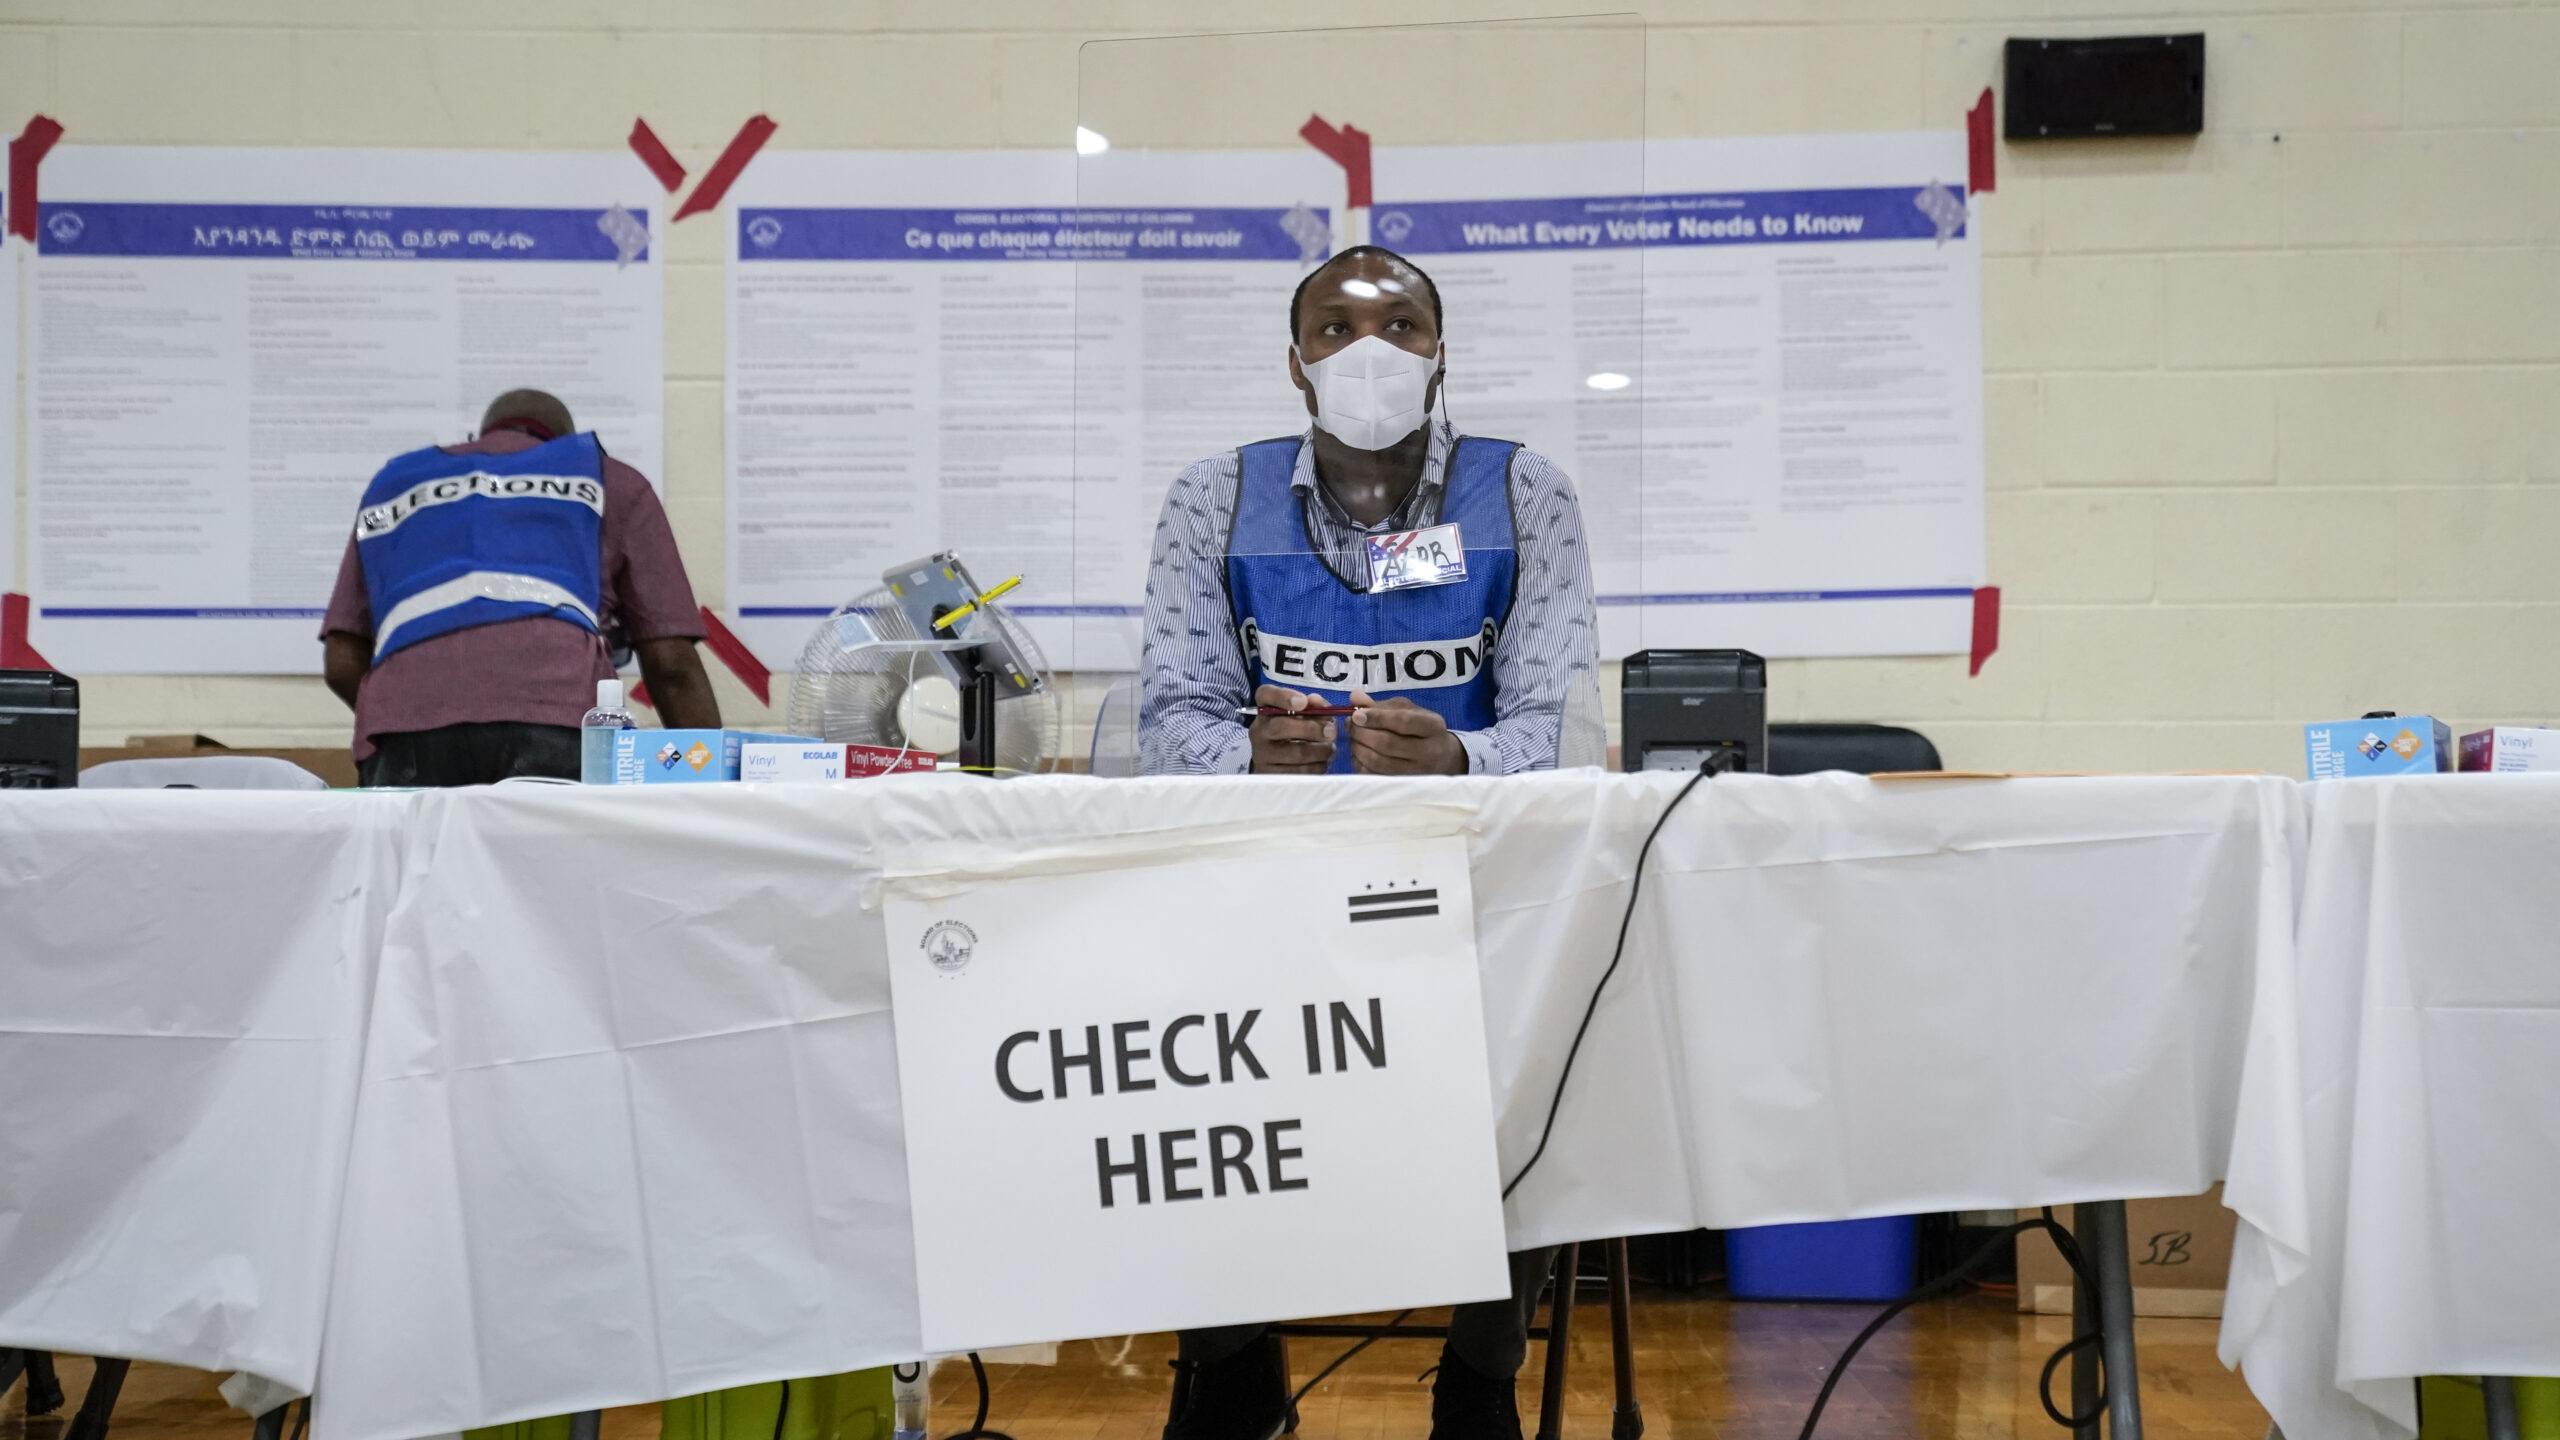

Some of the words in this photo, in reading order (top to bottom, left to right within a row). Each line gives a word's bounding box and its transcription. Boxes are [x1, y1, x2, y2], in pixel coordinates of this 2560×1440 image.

[905, 227, 932, 248] Ce
[937, 231, 974, 252] que
[978, 228, 1050, 252] chaque
[1054, 227, 1134, 248] électeur
[1138, 229, 1177, 248] doit
[1181, 229, 1243, 248] savoir
[1462, 222, 1529, 245] What
[1534, 220, 1601, 246] Every
[1605, 218, 1673, 241] Voter
[1678, 215, 1756, 238] Needs
[1761, 215, 1788, 236] to
[1794, 212, 1864, 234] Know
[2500, 735, 2533, 749] Vinyl
[748, 754, 776, 768] Vinyl
[802, 751, 838, 760] ECOLAB
[850, 750, 869, 768] Vinyl
[2332, 751, 2346, 780] ARGE
[633, 758, 645, 784] ARGE
[825, 768, 837, 779] M
[994, 1009, 1270, 1104] CHECK
[1301, 997, 1387, 1075] IN
[1094, 1118, 1309, 1209] HERE
